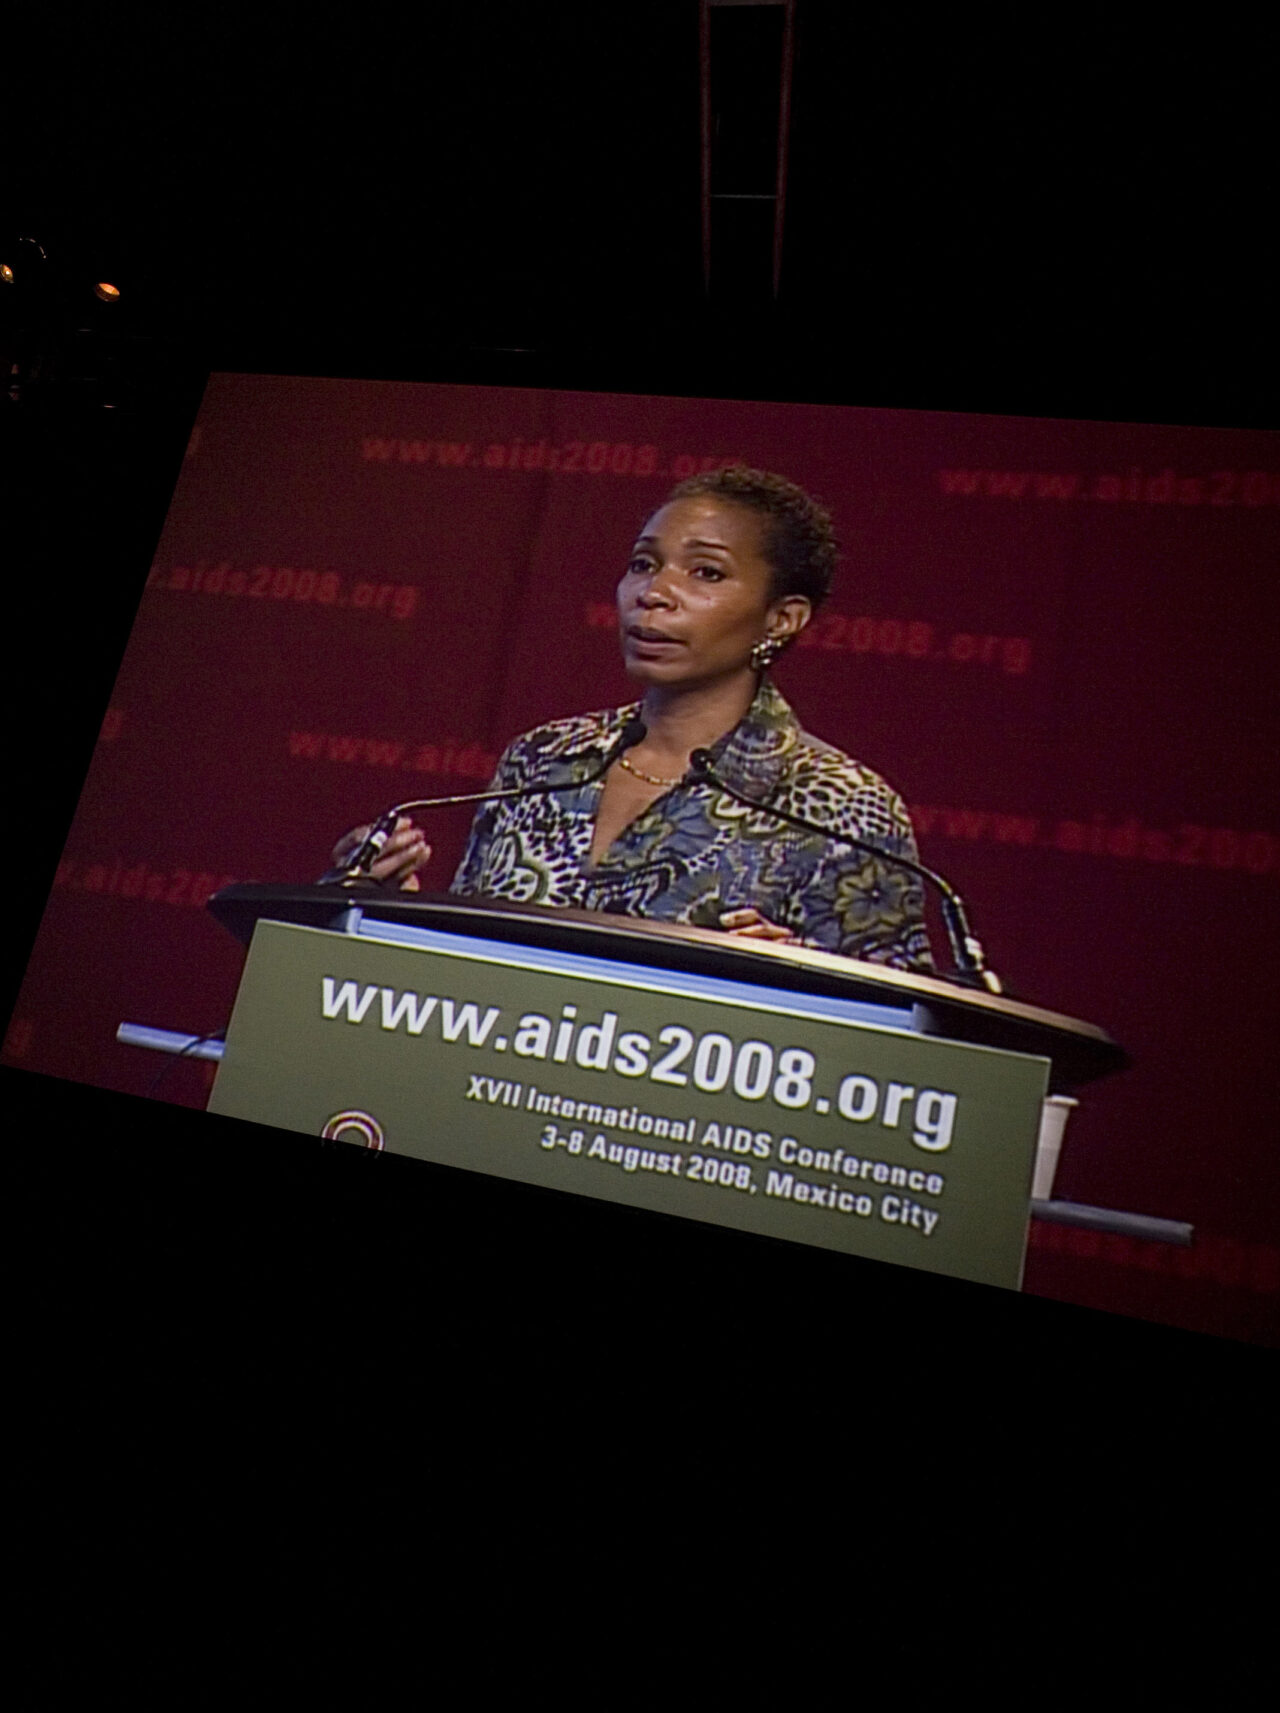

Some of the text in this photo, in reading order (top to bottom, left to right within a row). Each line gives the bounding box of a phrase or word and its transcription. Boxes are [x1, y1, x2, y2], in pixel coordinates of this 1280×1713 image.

[322, 976, 958, 1151] www.aids2008.org
[466, 1074, 943, 1195] XVII International AIDS Conference
[540, 1125, 939, 1235] 3-8 August 2008, Mexico City
